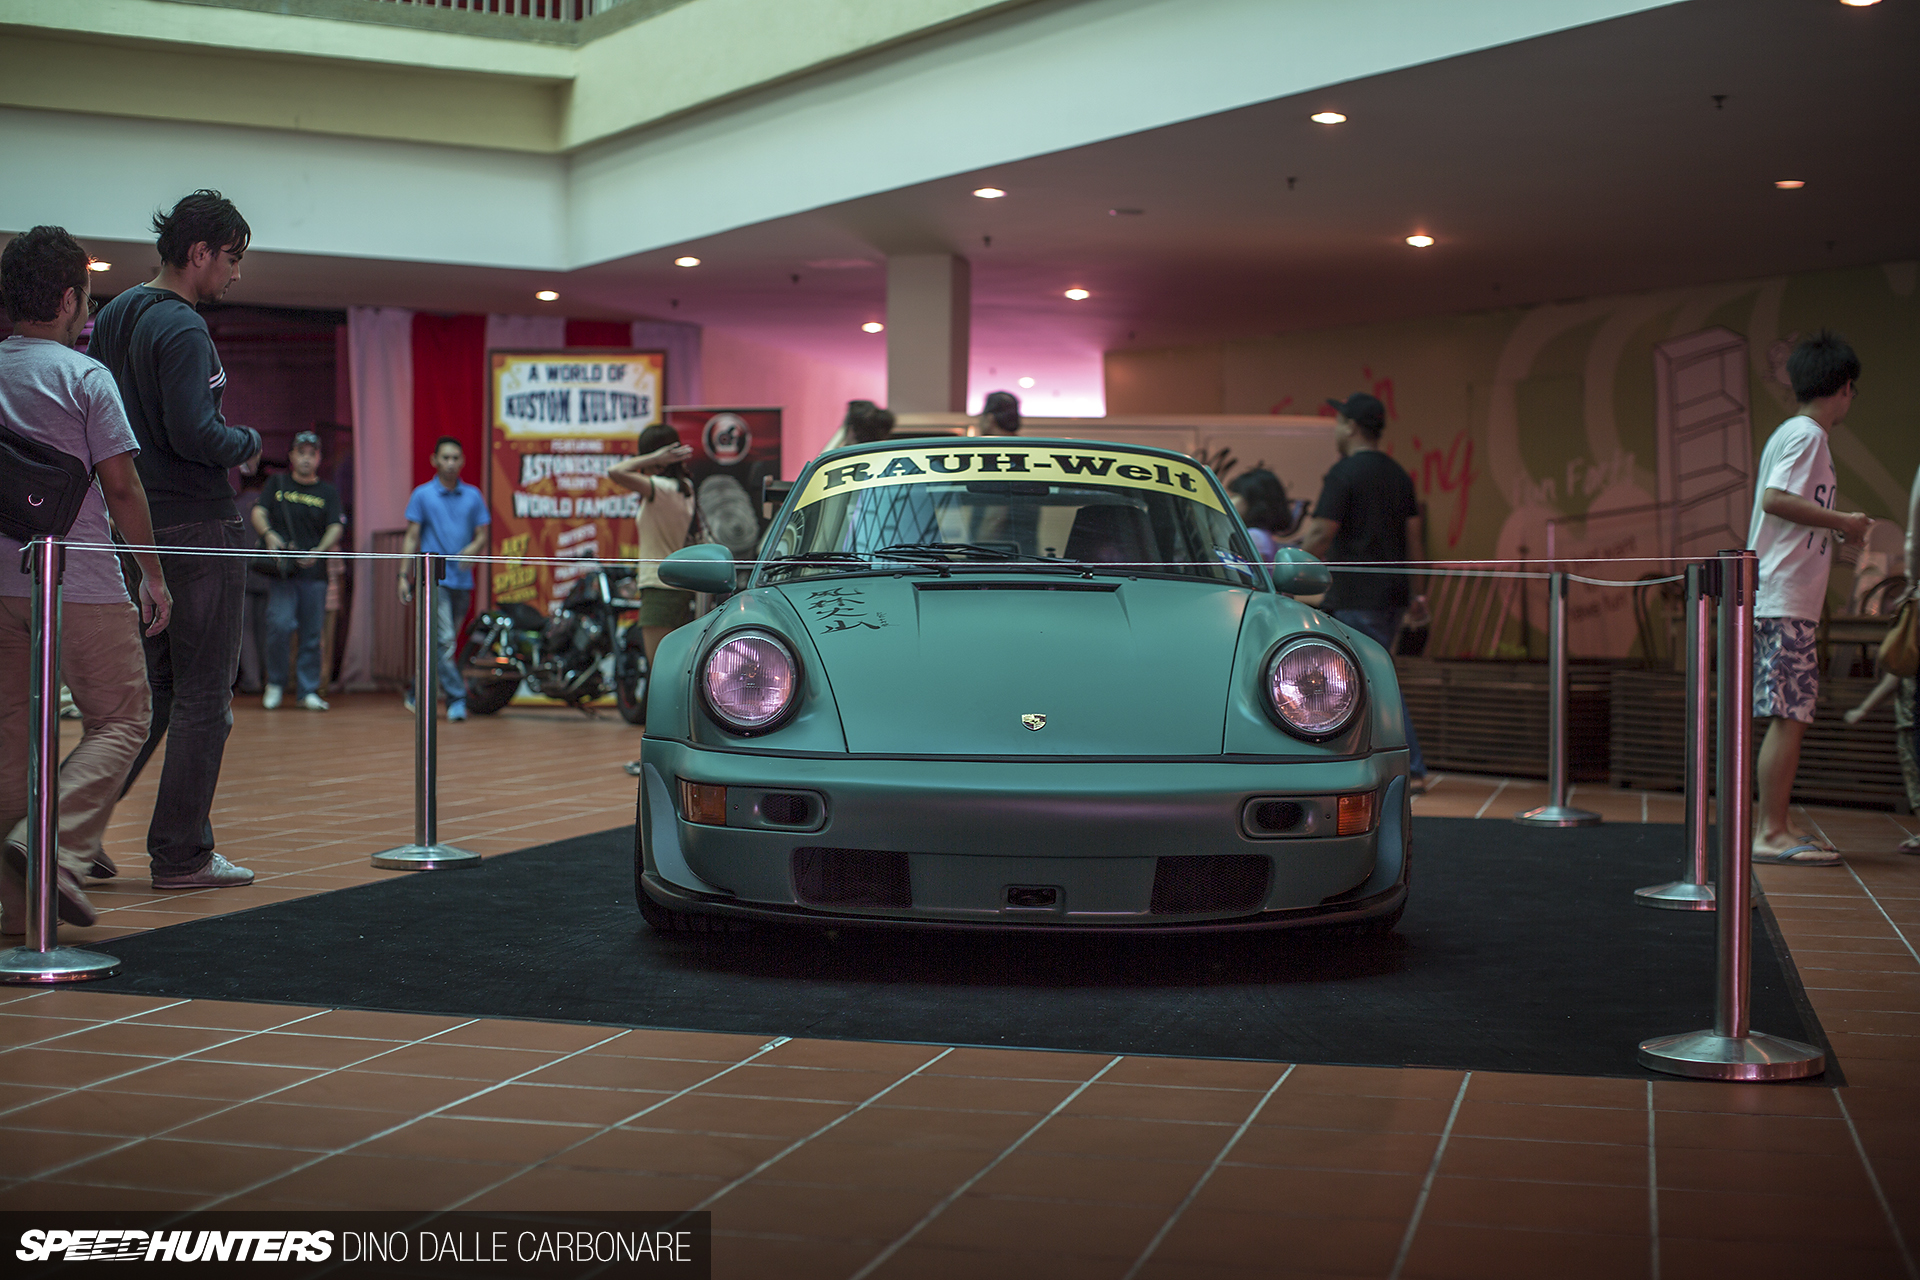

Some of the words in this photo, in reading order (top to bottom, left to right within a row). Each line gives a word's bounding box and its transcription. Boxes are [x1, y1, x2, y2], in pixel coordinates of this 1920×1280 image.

[528, 364, 539, 382] A
[545, 364, 603, 382] WORLD
[607, 364, 627, 382] OF
[505, 389, 571, 423] KUSTOM
[579, 389, 650, 424] KULTURE
[520, 454, 634, 488] ASTONISHI
[822, 453, 1198, 492] RAUH-Welt
[514, 491, 573, 518] WORLD
[575, 492, 641, 518] FAMOUS
